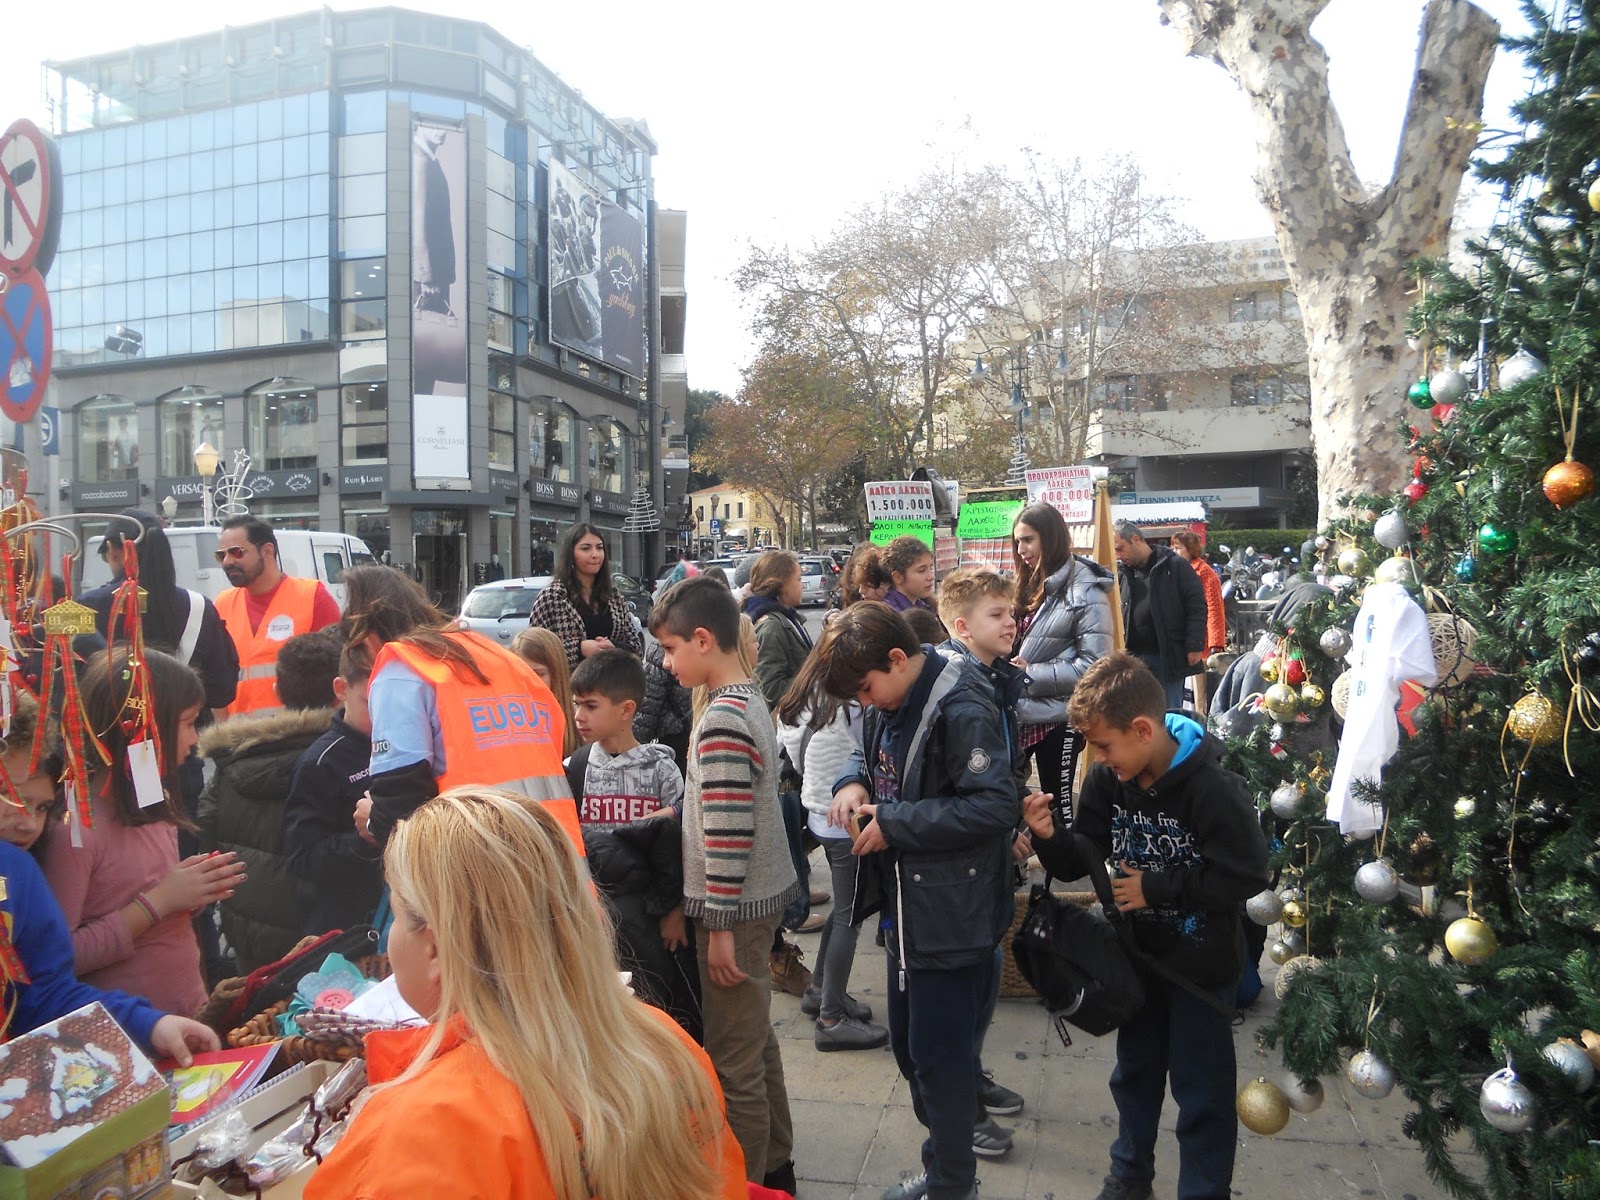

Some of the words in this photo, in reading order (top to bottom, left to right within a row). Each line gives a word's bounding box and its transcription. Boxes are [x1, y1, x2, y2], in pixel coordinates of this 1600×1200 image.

[417, 437, 465, 446] CORNELIANI
[171, 483, 204, 495] VERSAC
[536, 482, 554, 495] BOSS
[1047, 480, 1073, 488] ΛΑΧΕΙΟ
[81, 490, 128, 500] roccobarocco
[561, 487, 578, 499] BOSS
[870, 499, 932, 511] 1.500.000
[1139, 497, 1174, 505] ΕΘΝΙΚΗ
[1177, 495, 1221, 503] ΤΡΑΠΕΖΑ
[712, 520, 718, 528] P
[1061, 737, 1074, 767] RULES
[1060, 768, 1070, 783] MY
[1060, 785, 1070, 805] LIFE
[1062, 806, 1073, 820] MY
[1133, 810, 1152, 825] the
[1157, 812, 1179, 829] free
